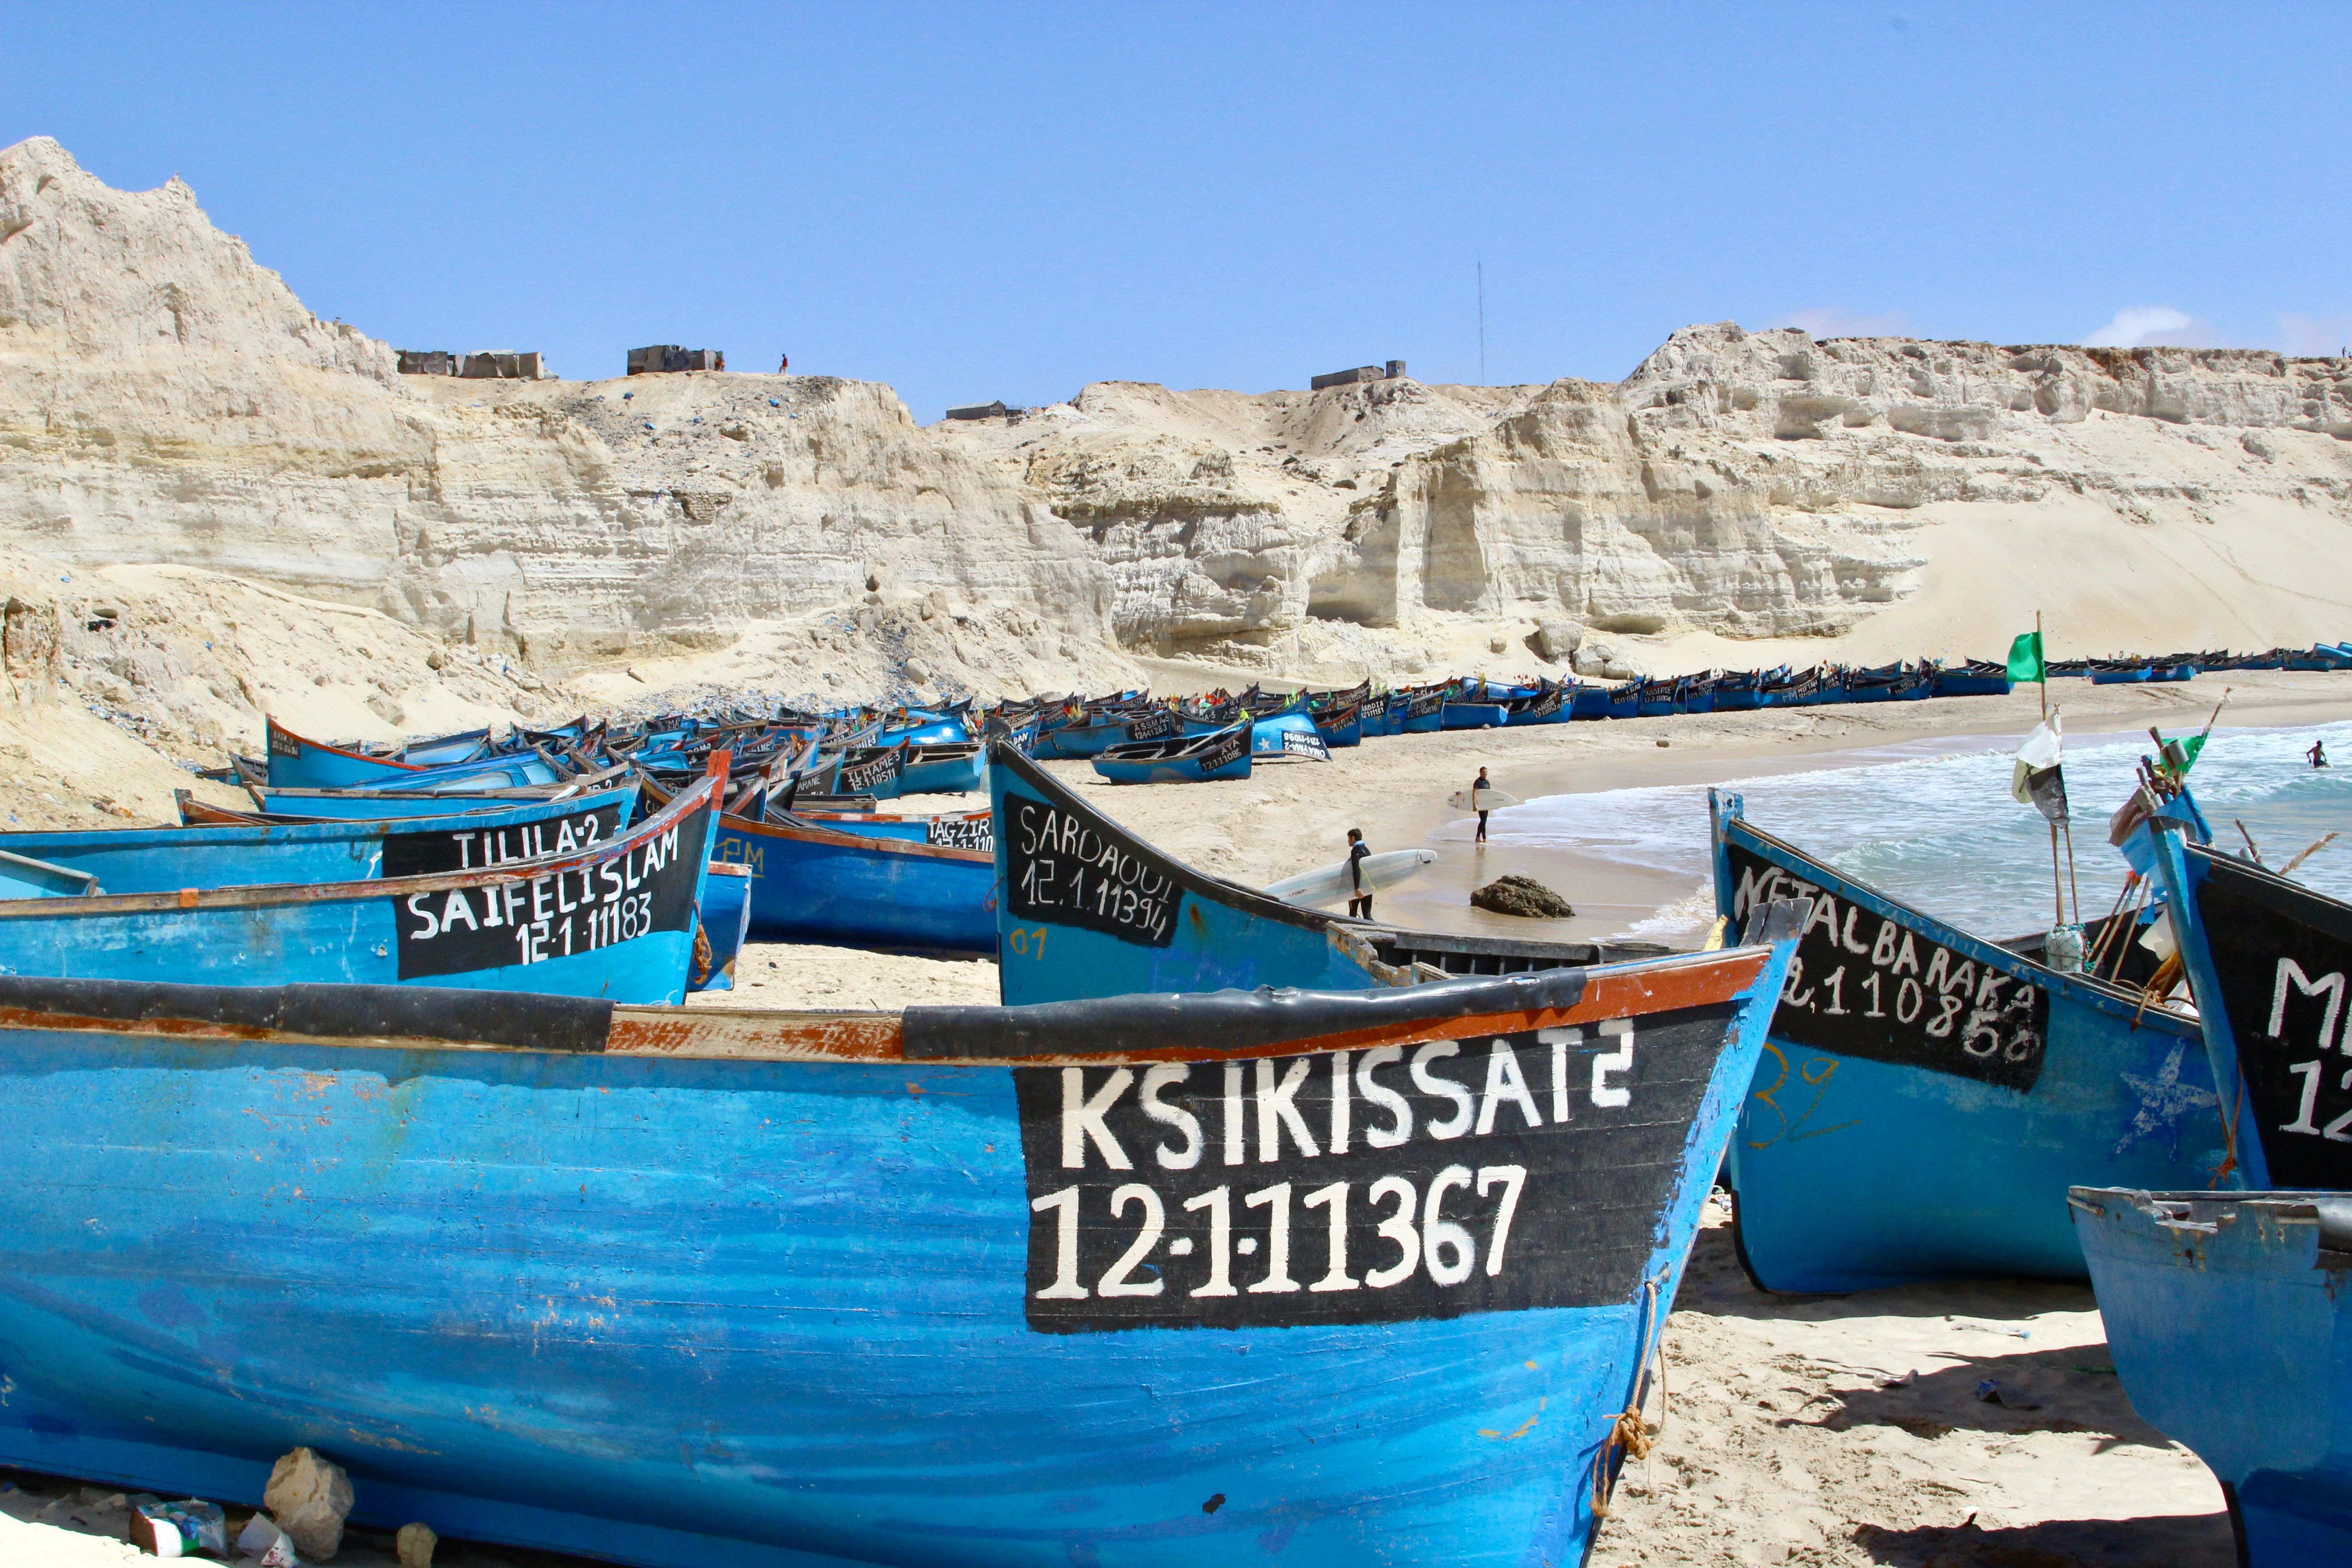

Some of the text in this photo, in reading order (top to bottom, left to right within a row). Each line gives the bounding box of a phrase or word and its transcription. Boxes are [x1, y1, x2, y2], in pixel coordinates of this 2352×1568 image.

[1221, 740, 1240, 755] AYA
[927, 818, 990, 838] TAGZIR
[1020, 805, 1172, 904] SARDAOUI
